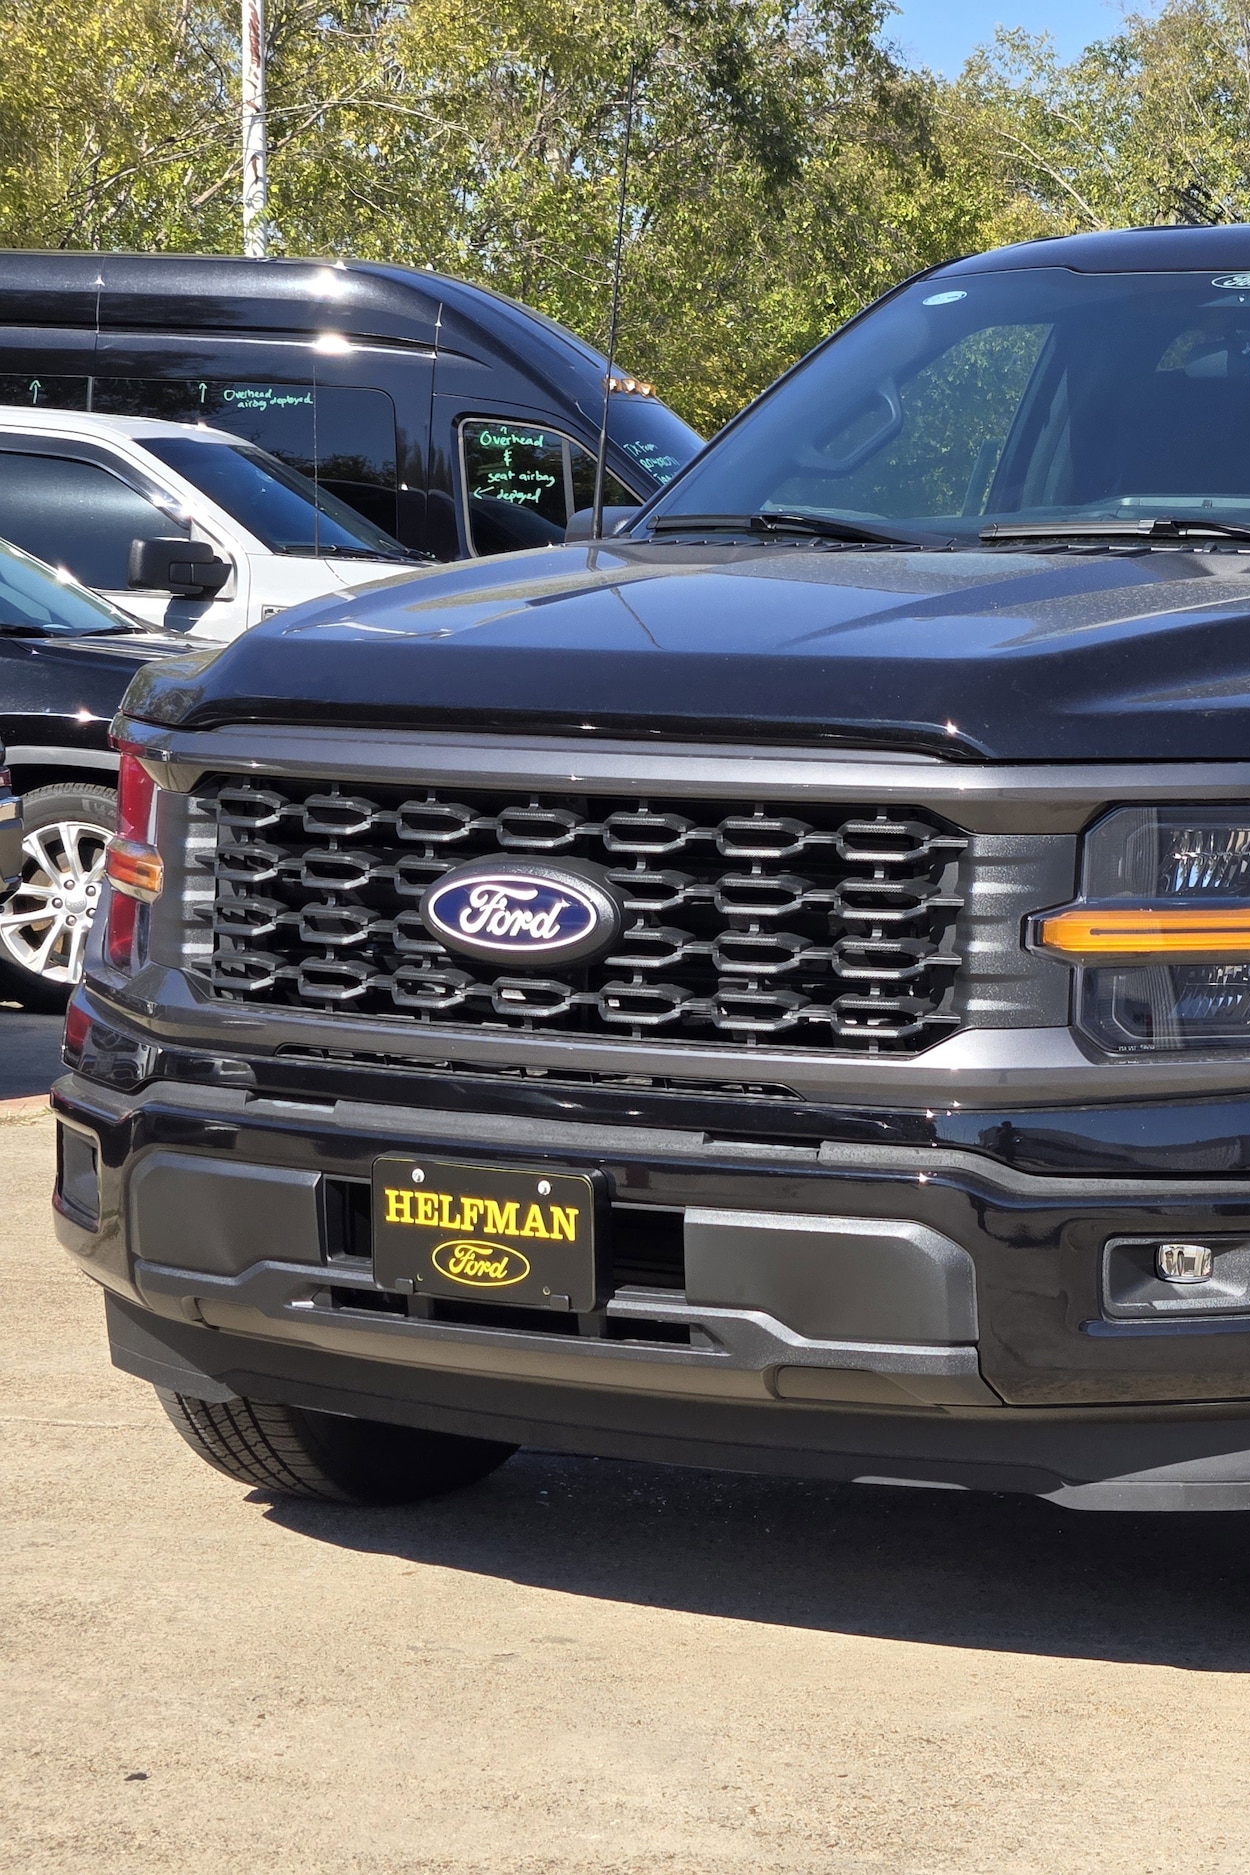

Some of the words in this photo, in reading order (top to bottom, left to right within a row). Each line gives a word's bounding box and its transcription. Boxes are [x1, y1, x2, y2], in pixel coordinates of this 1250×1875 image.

[223, 388, 273, 401] Overhead
[479, 430, 544, 448] Overhead
[487, 470, 516, 483] seat
[518, 470, 556, 488] airbag
[459, 882, 568, 941] Ford
[384, 1189, 579, 1242] HELFMAN
[447, 1244, 511, 1280] Ford
